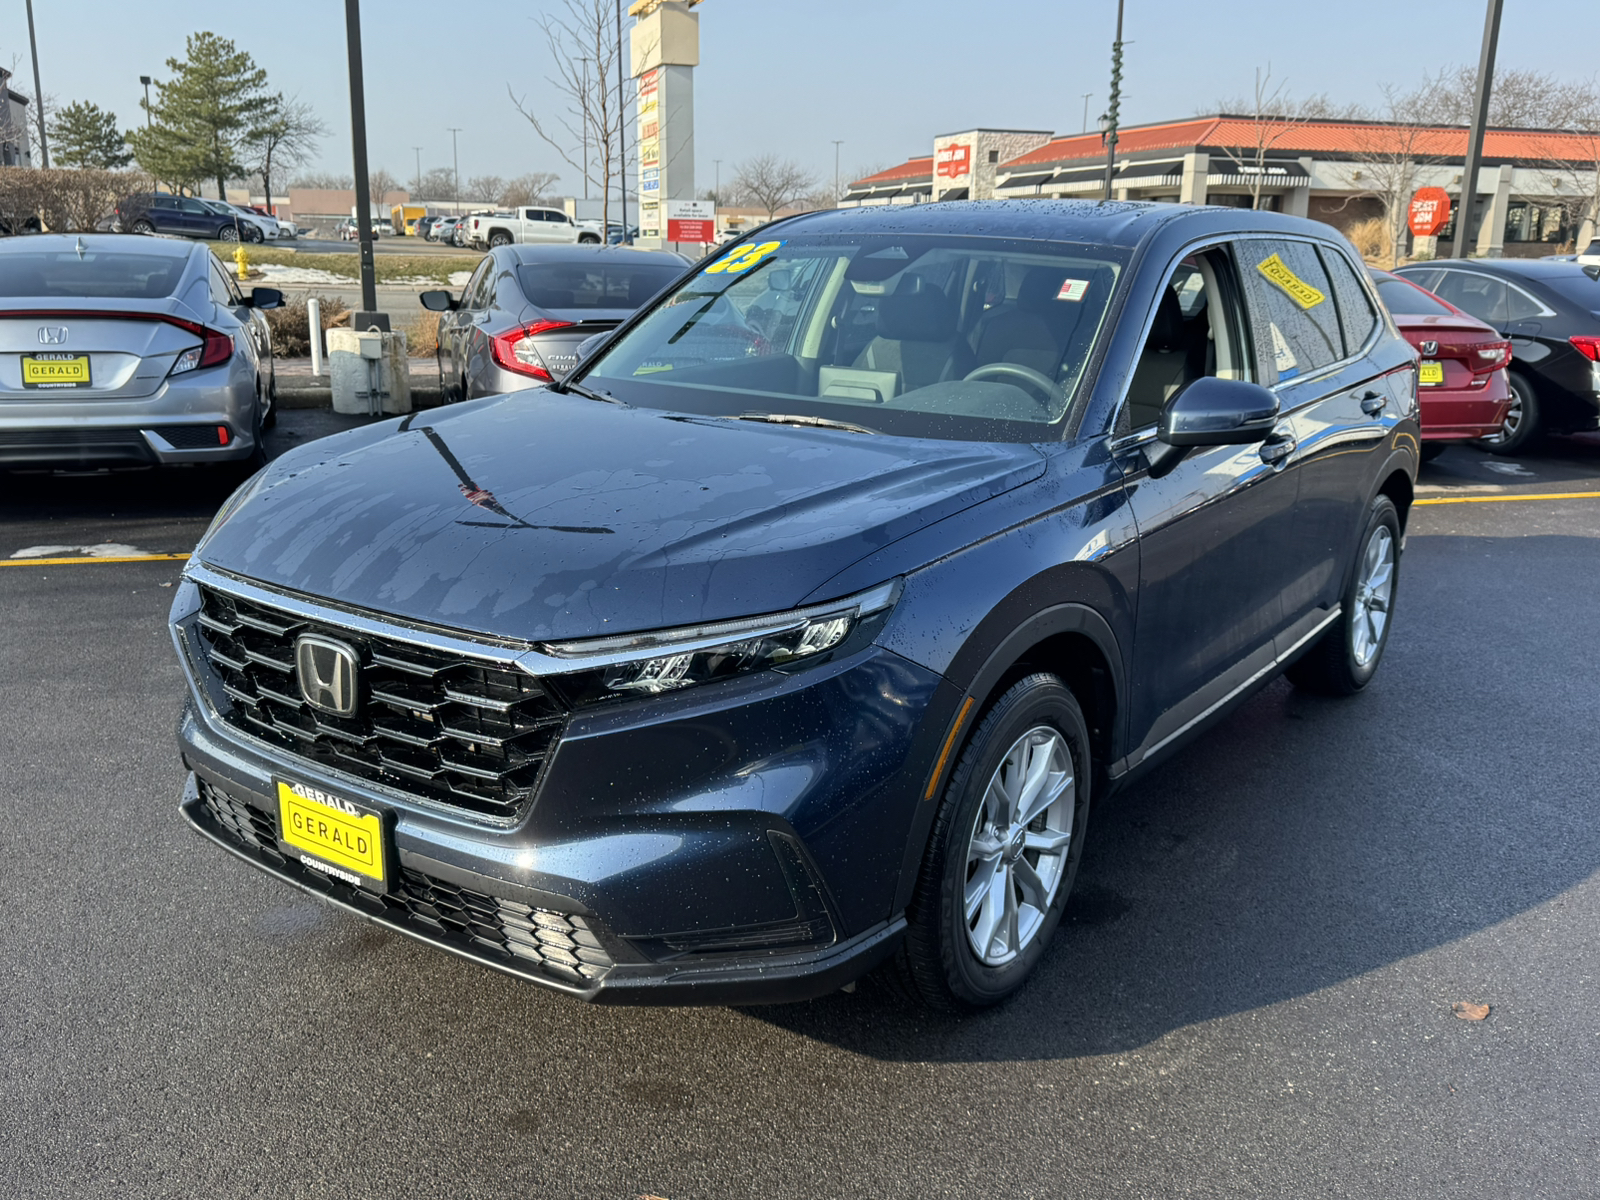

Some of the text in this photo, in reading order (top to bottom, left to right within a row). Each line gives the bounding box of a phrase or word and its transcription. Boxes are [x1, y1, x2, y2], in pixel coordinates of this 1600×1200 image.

[704, 241, 780, 273] 23
[32, 366, 80, 375] GERALD
[294, 783, 356, 816] GERALD
[293, 812, 368, 854] GERALD
[300, 854, 361, 886] COUNTRYSIDE
